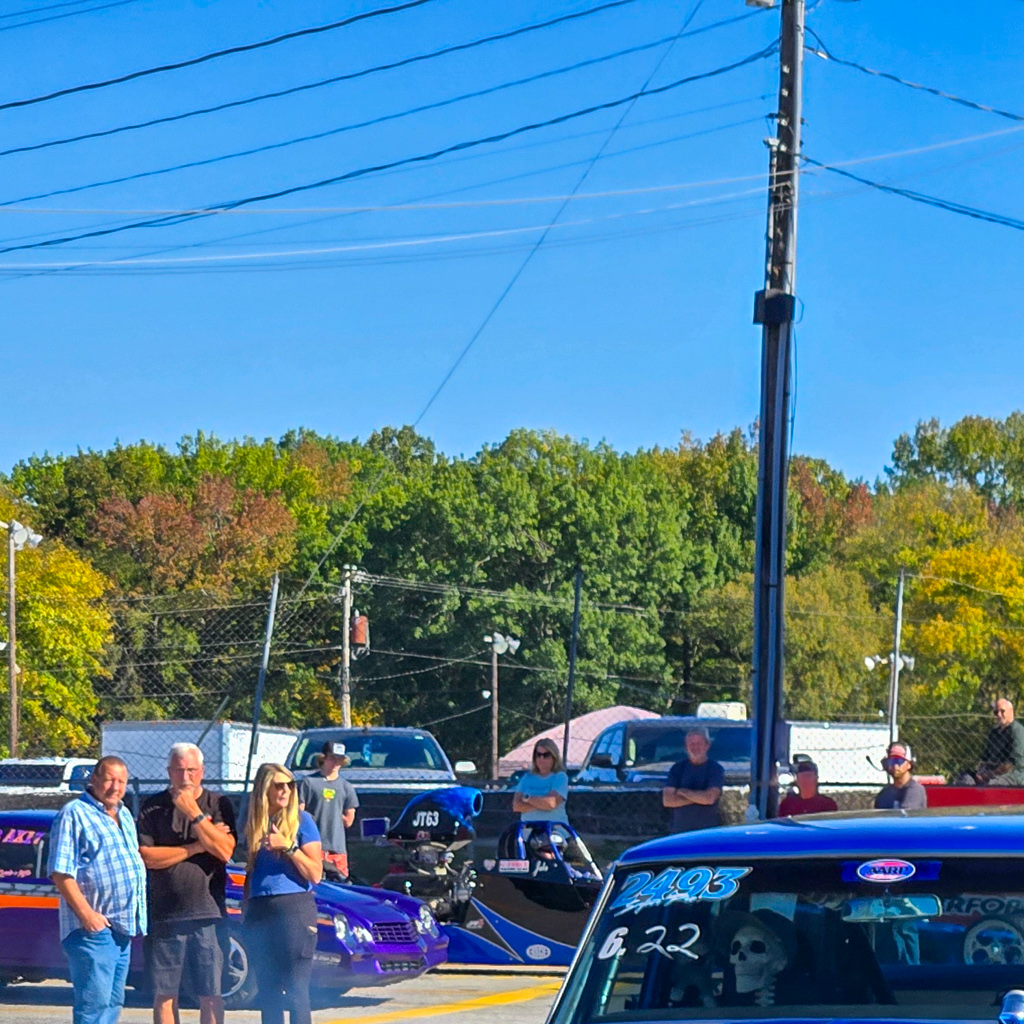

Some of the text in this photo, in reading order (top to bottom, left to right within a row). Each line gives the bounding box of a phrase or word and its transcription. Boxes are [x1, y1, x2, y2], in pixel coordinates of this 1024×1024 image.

[412, 810, 439, 827] JT63
[868, 865, 910, 876] AARP
[610, 866, 753, 910] 2493
